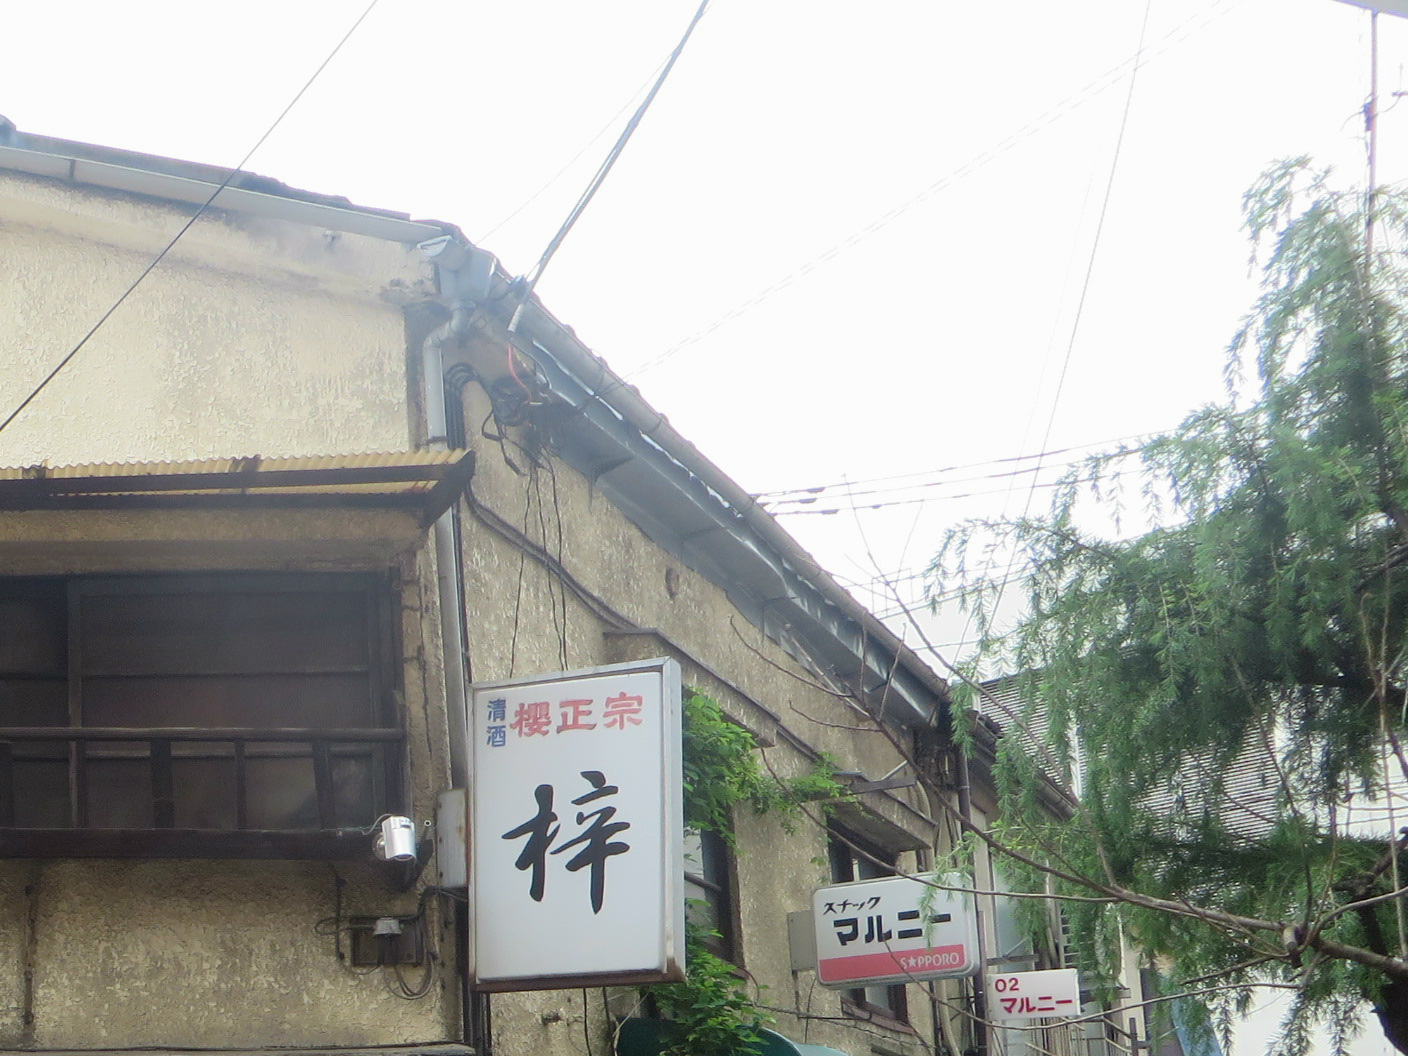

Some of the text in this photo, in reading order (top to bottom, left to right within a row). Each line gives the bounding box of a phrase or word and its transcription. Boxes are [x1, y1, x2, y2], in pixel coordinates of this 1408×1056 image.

[486, 698, 507, 748] 清酒
[509, 691, 643, 738] 櫻正宗
[500, 770, 631, 915] 梓
[823, 896, 881, 915] スナック
[832, 909, 952, 946] マルニー
[999, 996, 1073, 1013] マルニー
